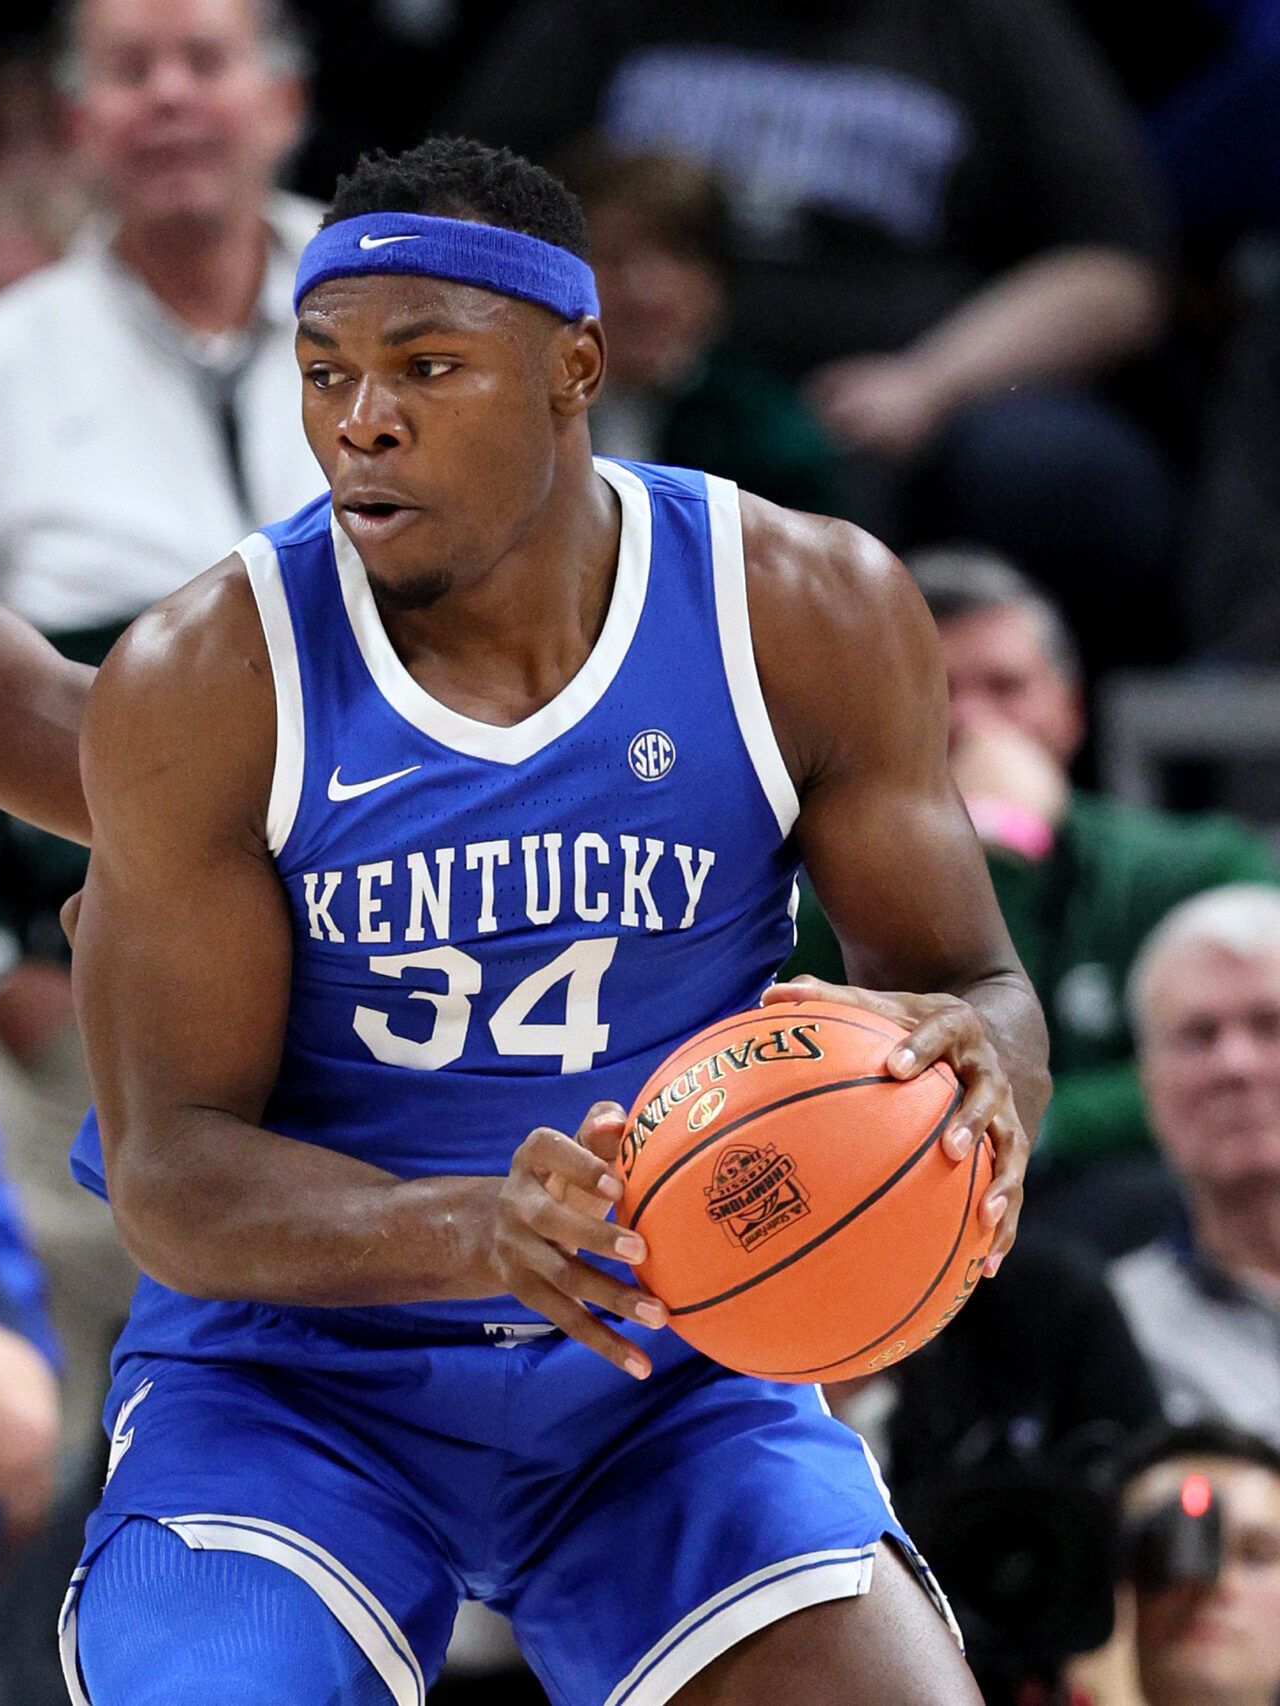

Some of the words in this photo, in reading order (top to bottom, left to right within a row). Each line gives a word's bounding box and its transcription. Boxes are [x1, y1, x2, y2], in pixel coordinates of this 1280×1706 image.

[633, 738, 673, 772] SEC
[303, 832, 716, 944] KENTUCKY
[352, 937, 619, 1075] 34
[621, 1023, 824, 1180] SPALDING
[709, 1157, 795, 1222] CHAMPIONS
[719, 1158, 770, 1196] CLASSIC
